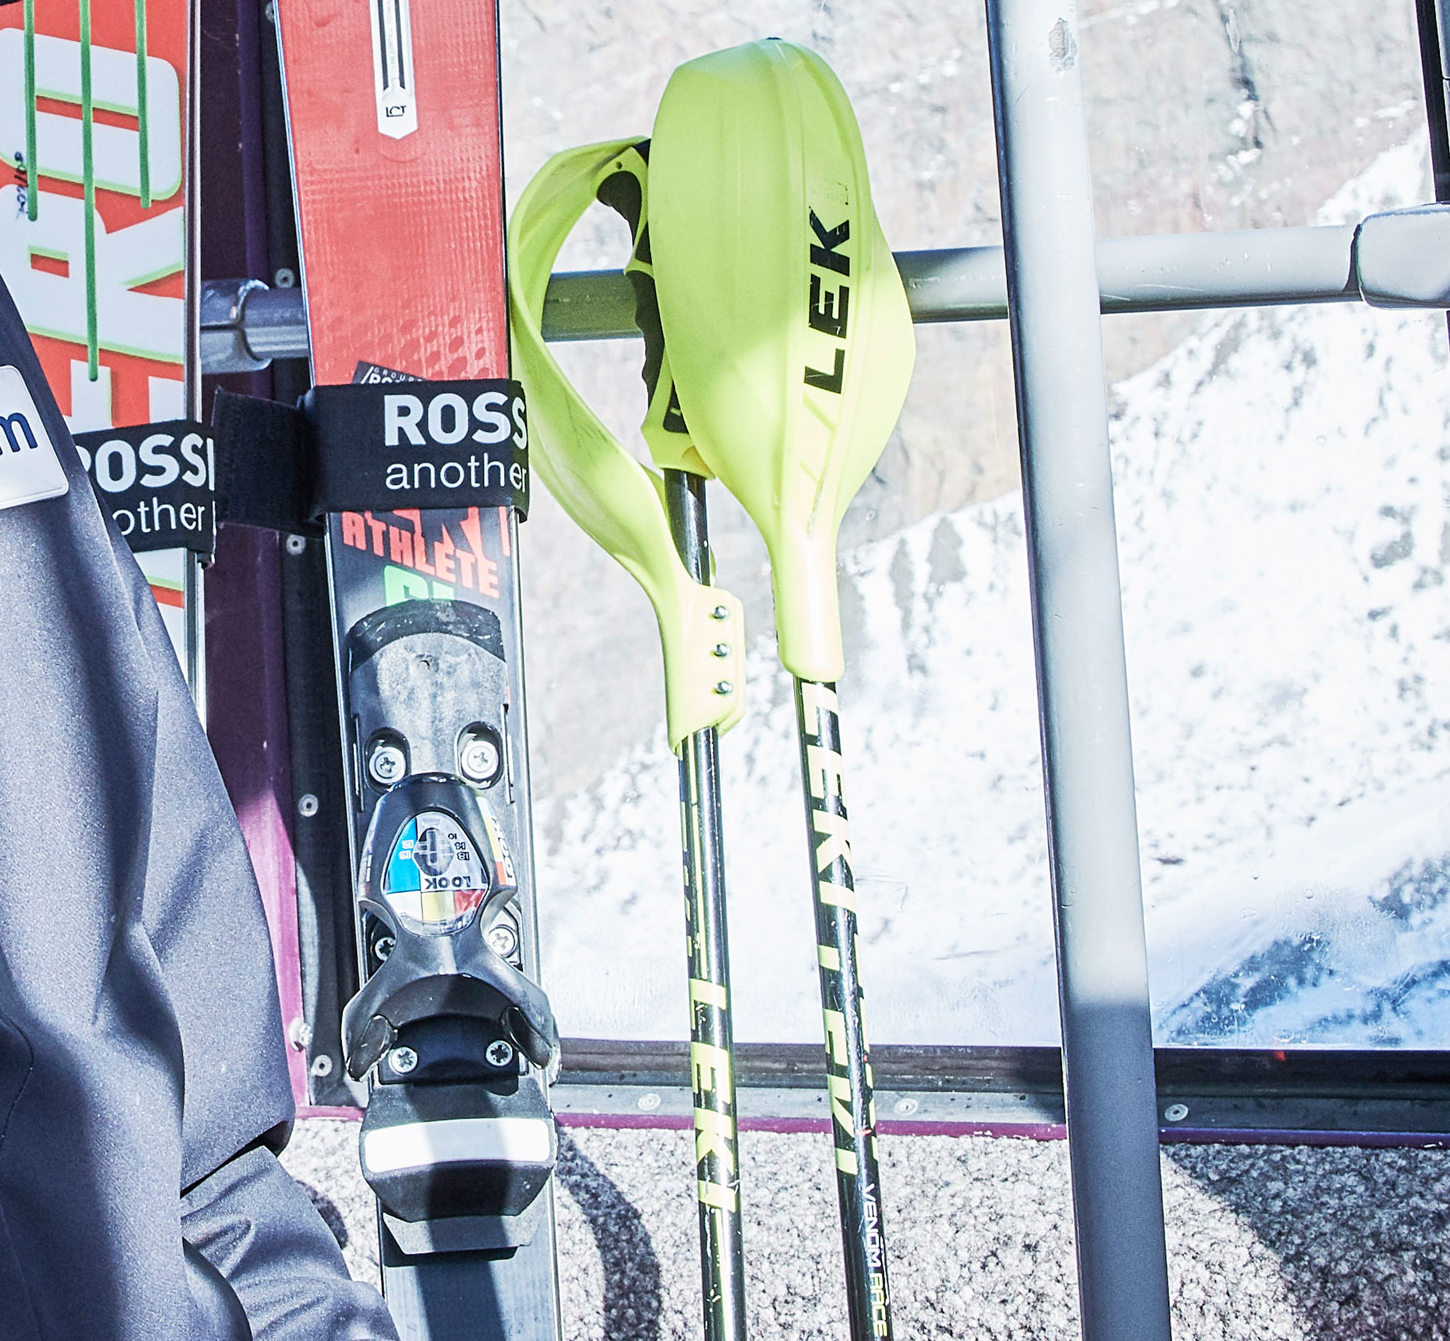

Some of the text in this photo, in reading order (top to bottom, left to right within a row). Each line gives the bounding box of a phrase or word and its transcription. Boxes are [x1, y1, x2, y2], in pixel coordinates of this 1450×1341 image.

[373, 366, 423, 383] GROUP
[383, 391, 529, 450] ROSS
[384, 452, 528, 493] another
[341, 511, 500, 599] ATHLETE
[801, 681, 857, 914] LEKI
[688, 978, 738, 1213] LEKI
[861, 1182, 882, 1268] VENOM
[870, 1272, 889, 1338] RACE
